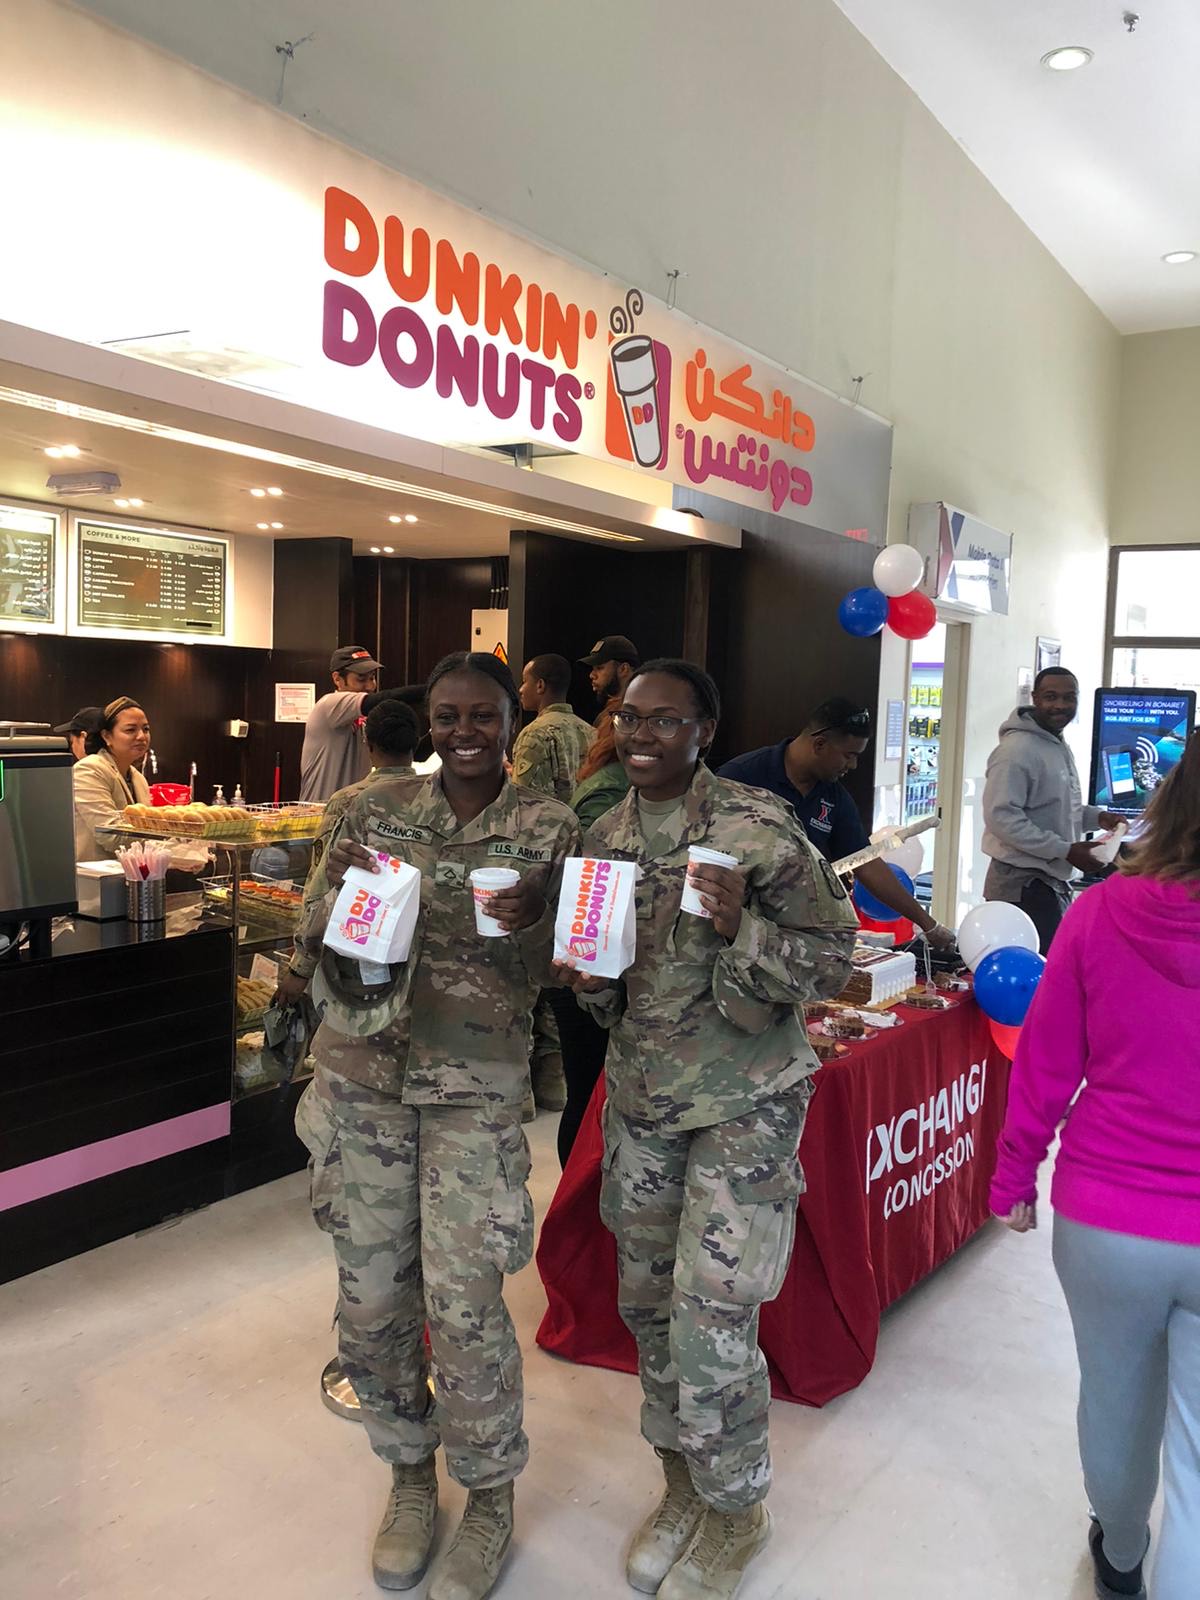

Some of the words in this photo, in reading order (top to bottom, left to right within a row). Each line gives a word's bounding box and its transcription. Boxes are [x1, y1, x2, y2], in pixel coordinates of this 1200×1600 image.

[324, 186, 597, 370] DUNKIN'
[685, 348, 816, 452] دانكن
[632, 402, 654, 425] DD
[86, 530, 113, 539] COFFEE
[121, 535, 141, 543] MORE
[1152, 701, 1185, 709] BONAIRE?
[376, 821, 423, 840] FRANCIS
[494, 844, 513, 854] U.S.
[517, 846, 545, 860] ARMY
[585, 861, 612, 938] DONUTS
